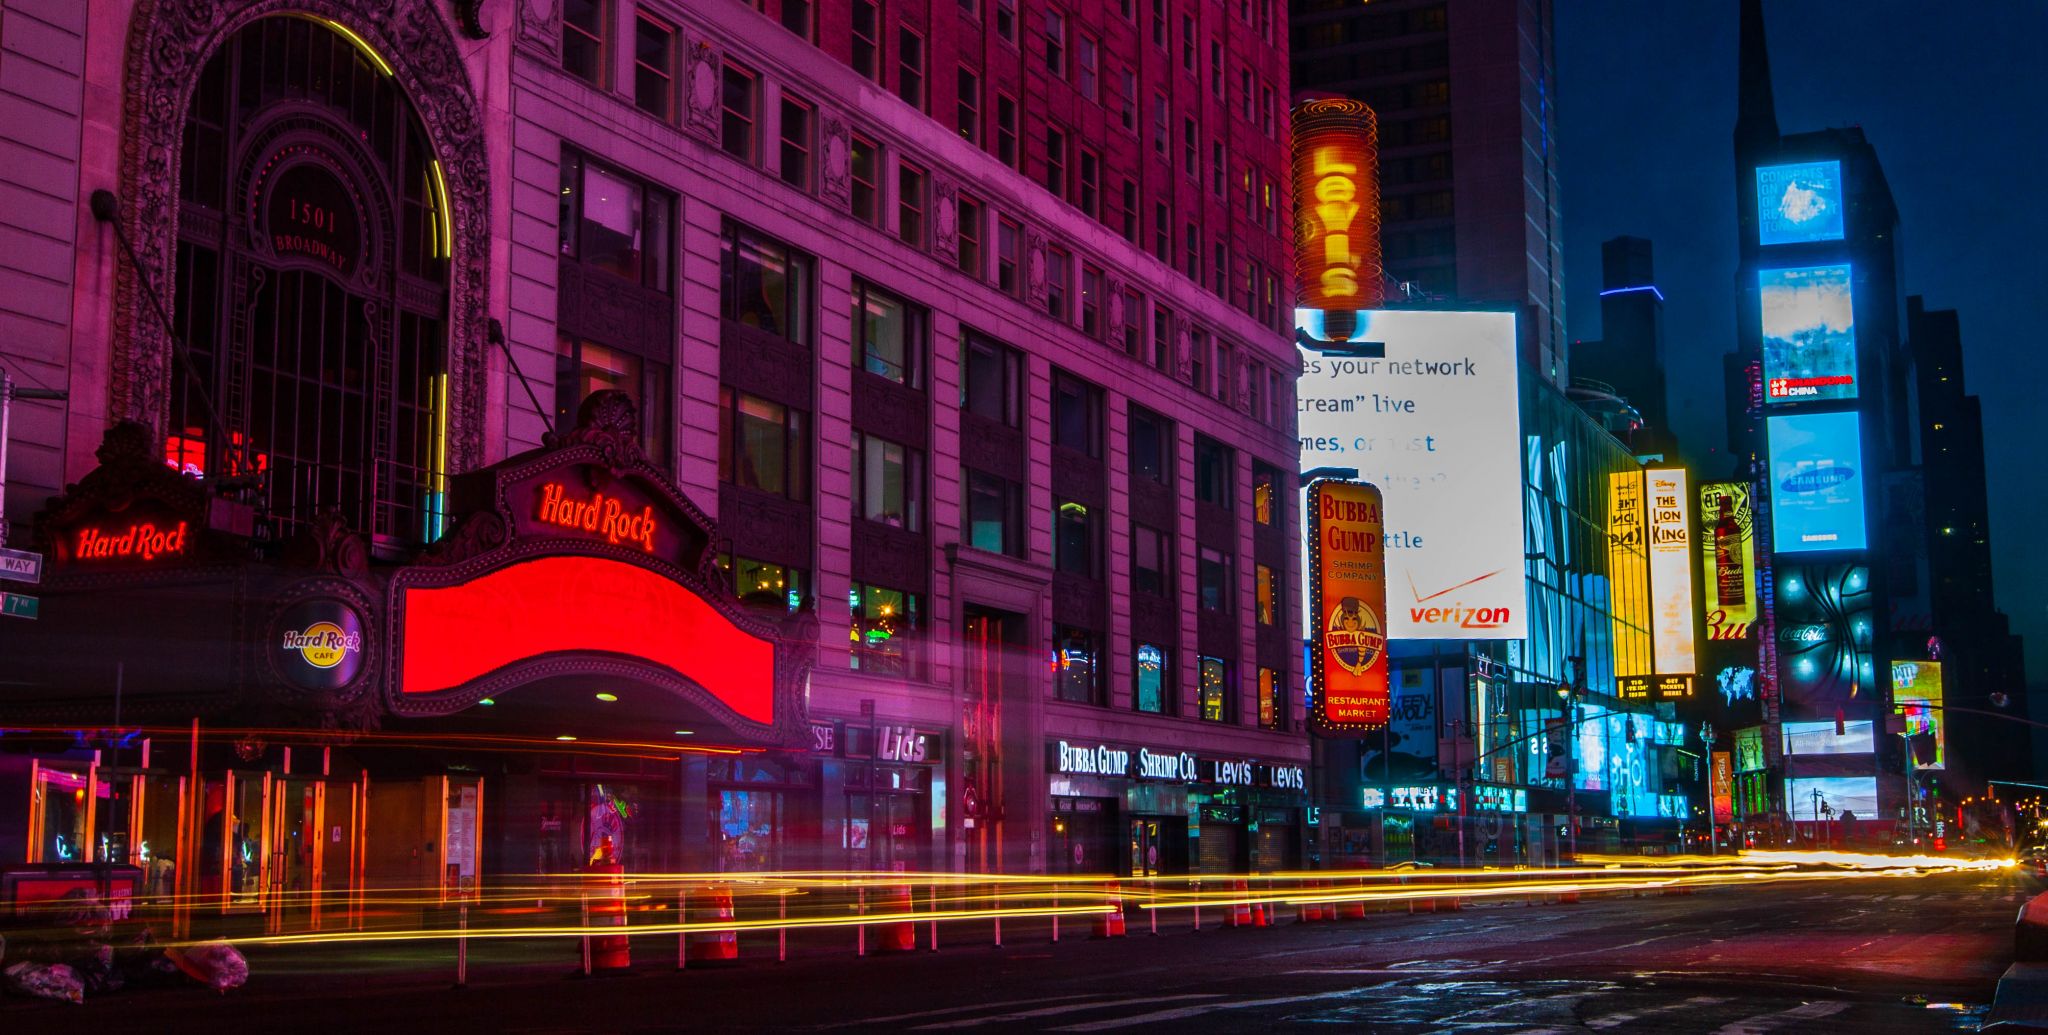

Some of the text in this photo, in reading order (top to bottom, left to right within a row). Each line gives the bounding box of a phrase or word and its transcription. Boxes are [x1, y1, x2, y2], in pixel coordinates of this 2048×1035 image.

[290, 198, 334, 233] 1501
[275, 235, 346, 269] BROADWAY
[1331, 361, 1380, 378] your
[1389, 358, 1475, 377] network
[1789, 386, 1817, 396] CHINA
[1372, 394, 1415, 412] live
[1790, 475, 1846, 486] SAMSUNG
[1323, 493, 1379, 523] BUBBA
[1655, 496, 1677, 506] THE
[541, 483, 656, 550] Hard Rock
[1653, 508, 1681, 524] LION
[77, 525, 137, 559] Hard
[1328, 525, 1376, 553] GUMP
[1652, 525, 1686, 545] KING
[5, 559, 31, 572] WAY
[1333, 560, 1373, 570] SHRIMP
[1328, 571, 1377, 581] COMPANY
[11, 597, 19, 613] 7
[1410, 602, 1510, 629] verizon
[283, 630, 360, 652] Hard Rock
[1328, 632, 1383, 648] BUBBA GUMP
[1328, 696, 1386, 706] RESTAURANT
[1338, 708, 1377, 718] MARKET
[1392, 705, 1433, 721] WOLF
[880, 725, 926, 763] Lids
[1059, 741, 1130, 776] BUBBA GUMP
[1140, 747, 1179, 779] SHRIMP
